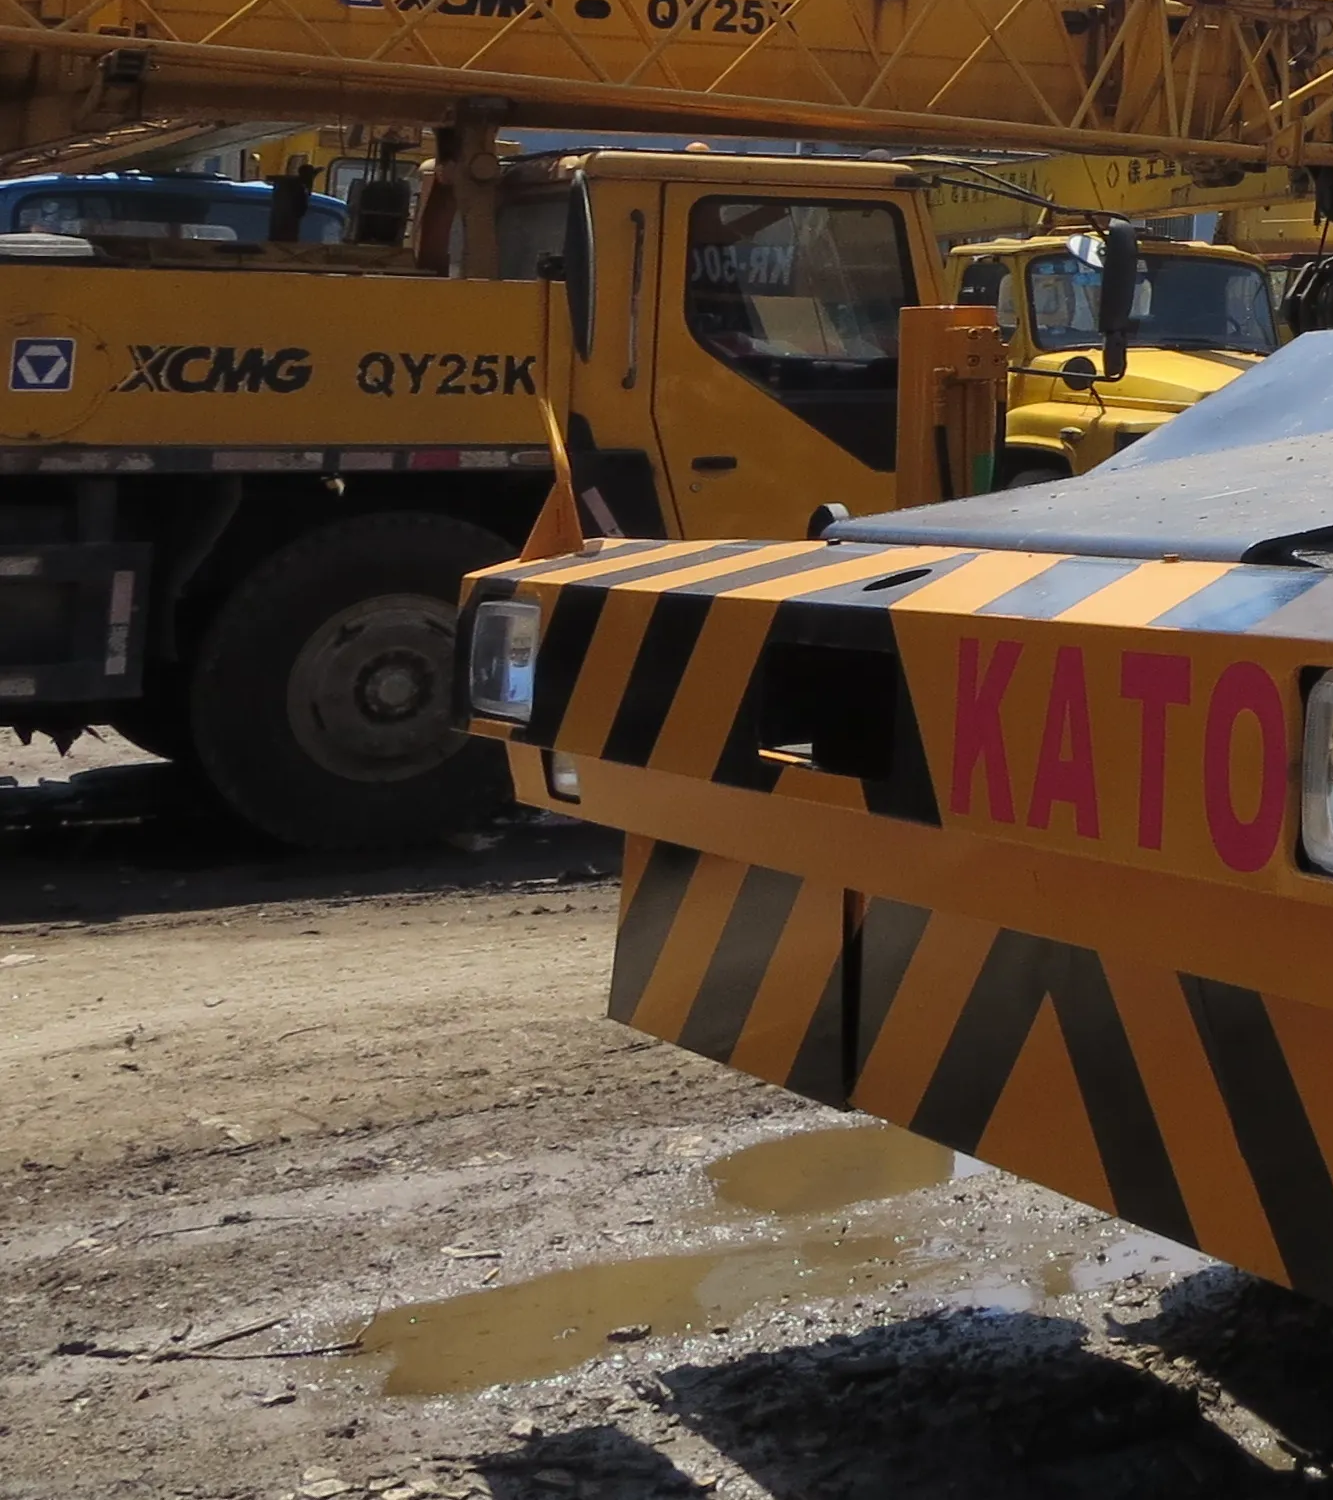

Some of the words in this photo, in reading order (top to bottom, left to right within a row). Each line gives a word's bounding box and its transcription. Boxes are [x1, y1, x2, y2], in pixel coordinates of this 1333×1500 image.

[109, 344, 314, 394] XCMG
[356, 351, 537, 398] QY25K
[950, 636, 1287, 873] KATO
